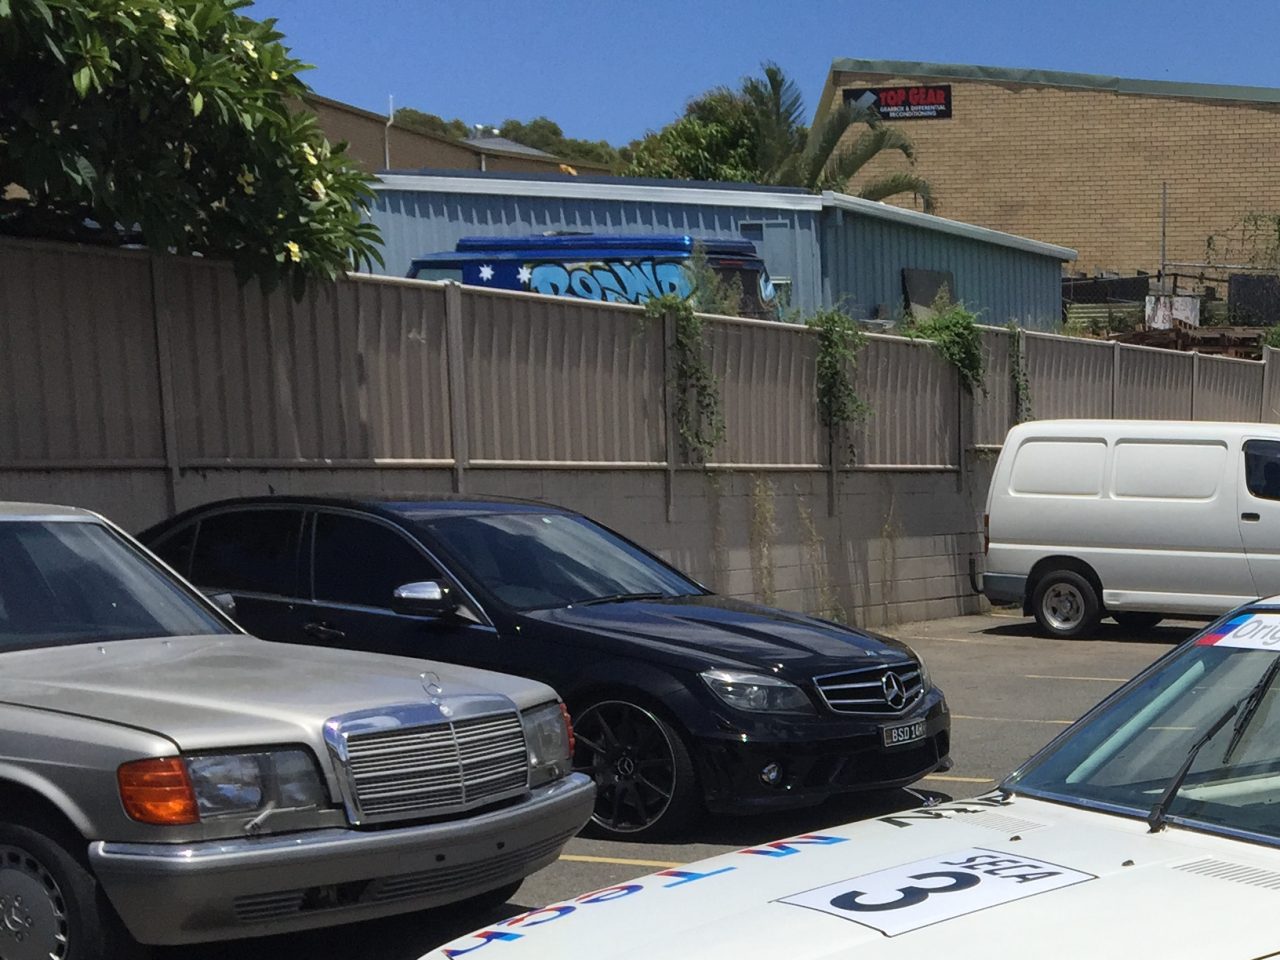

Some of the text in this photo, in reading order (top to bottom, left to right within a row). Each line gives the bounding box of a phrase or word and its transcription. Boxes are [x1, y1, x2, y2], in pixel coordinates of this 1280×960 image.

[880, 87, 946, 106] TOP GEAR
[892, 726, 910, 742] BSD
[737, 833, 851, 859] M
[939, 853, 1064, 885] SECA
[830, 870, 982, 912] 3
